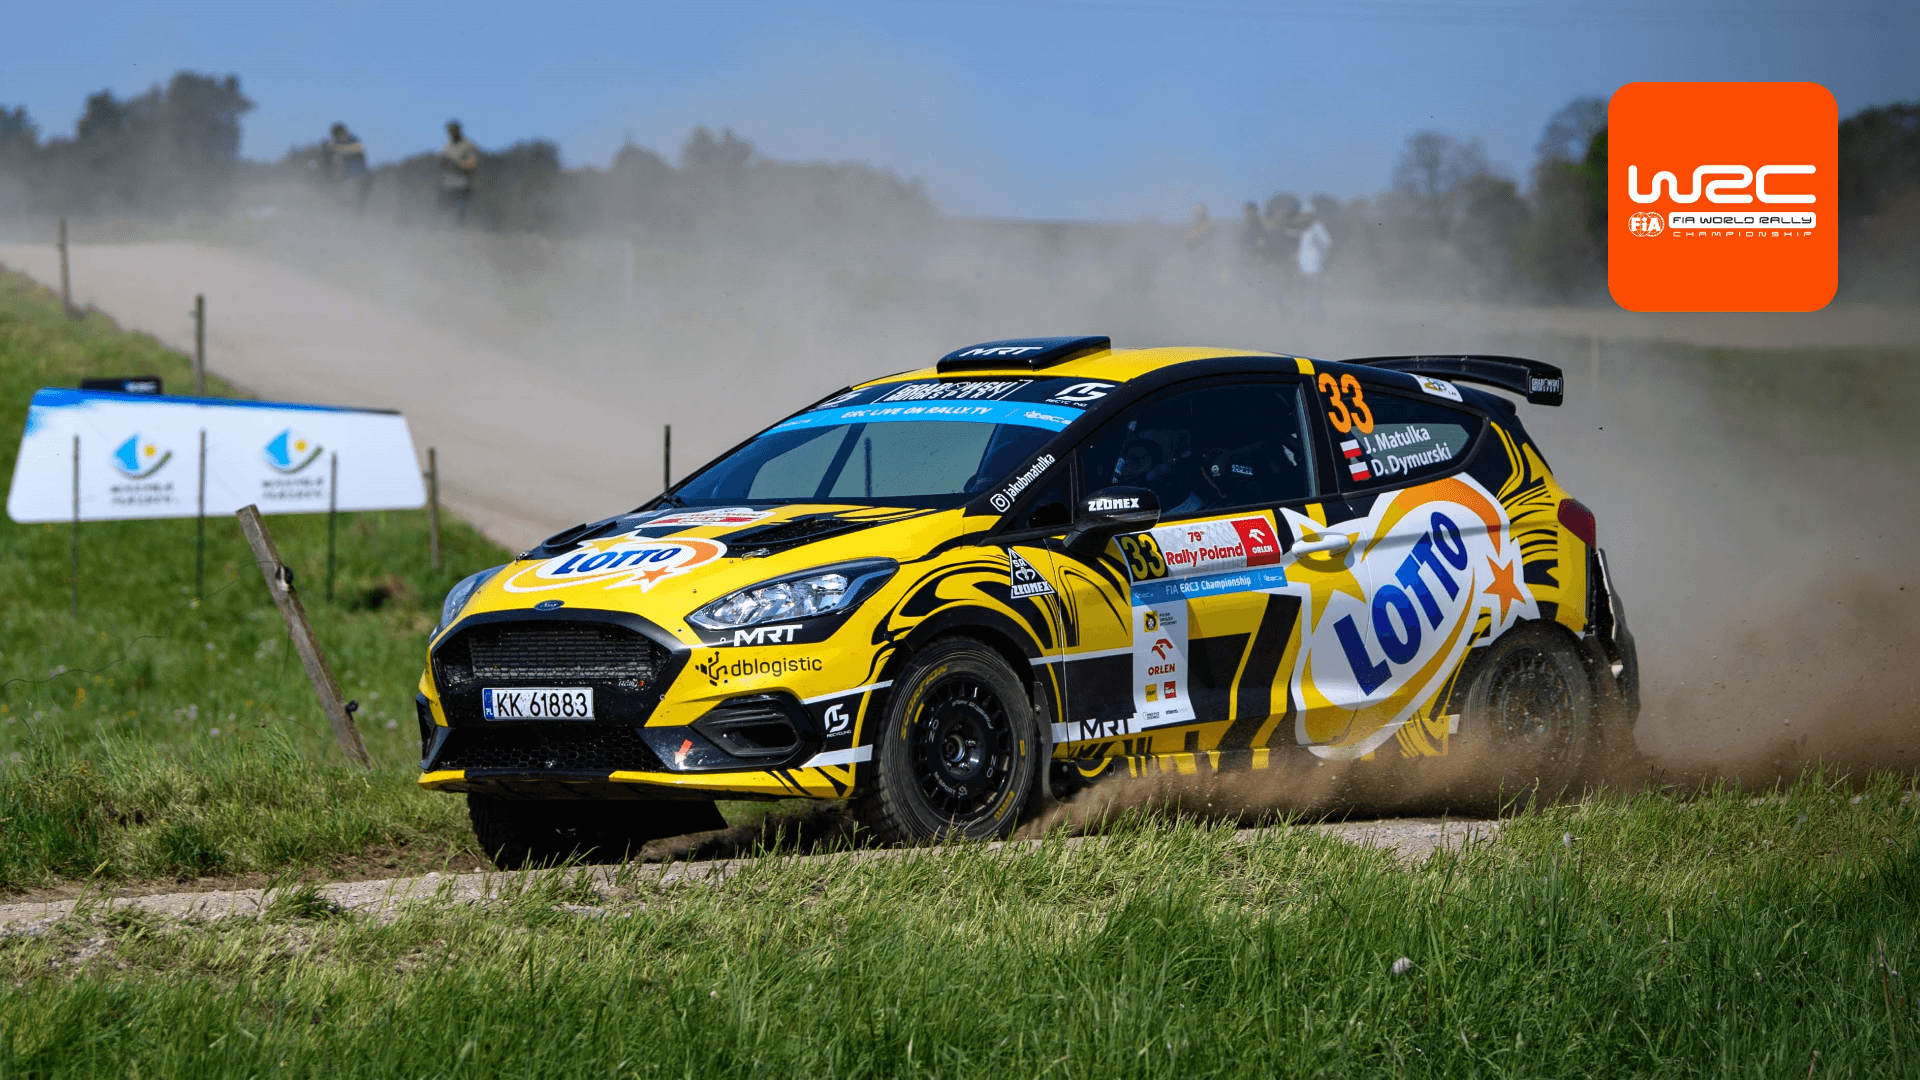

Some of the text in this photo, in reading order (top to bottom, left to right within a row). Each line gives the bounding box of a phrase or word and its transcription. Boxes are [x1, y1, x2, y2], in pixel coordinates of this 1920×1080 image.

[959, 347, 1043, 356] MRT
[870, 407, 905, 416] LIVE
[1318, 373, 1373, 433] 33
[1364, 425, 1431, 455] J. Matulka
[1371, 442, 1453, 477] D. Dymurski
[1003, 453, 1056, 502] jakubmatulka
[551, 547, 682, 575] LOTTO
[1121, 534, 1166, 580] 33
[1166, 543, 1244, 567] Rally Poland
[1251, 545, 1273, 554] ORLEN
[1166, 584, 1179, 595] FIA
[1180, 581, 1199, 593] ERC3
[1201, 575, 1252, 590] Championship
[1333, 511, 1468, 697] LOTTO
[733, 624, 802, 647] MRT
[731, 654, 822, 677] dblogistic
[1148, 663, 1175, 676] ORLEN
[497, 691, 588, 717] KK 61883
